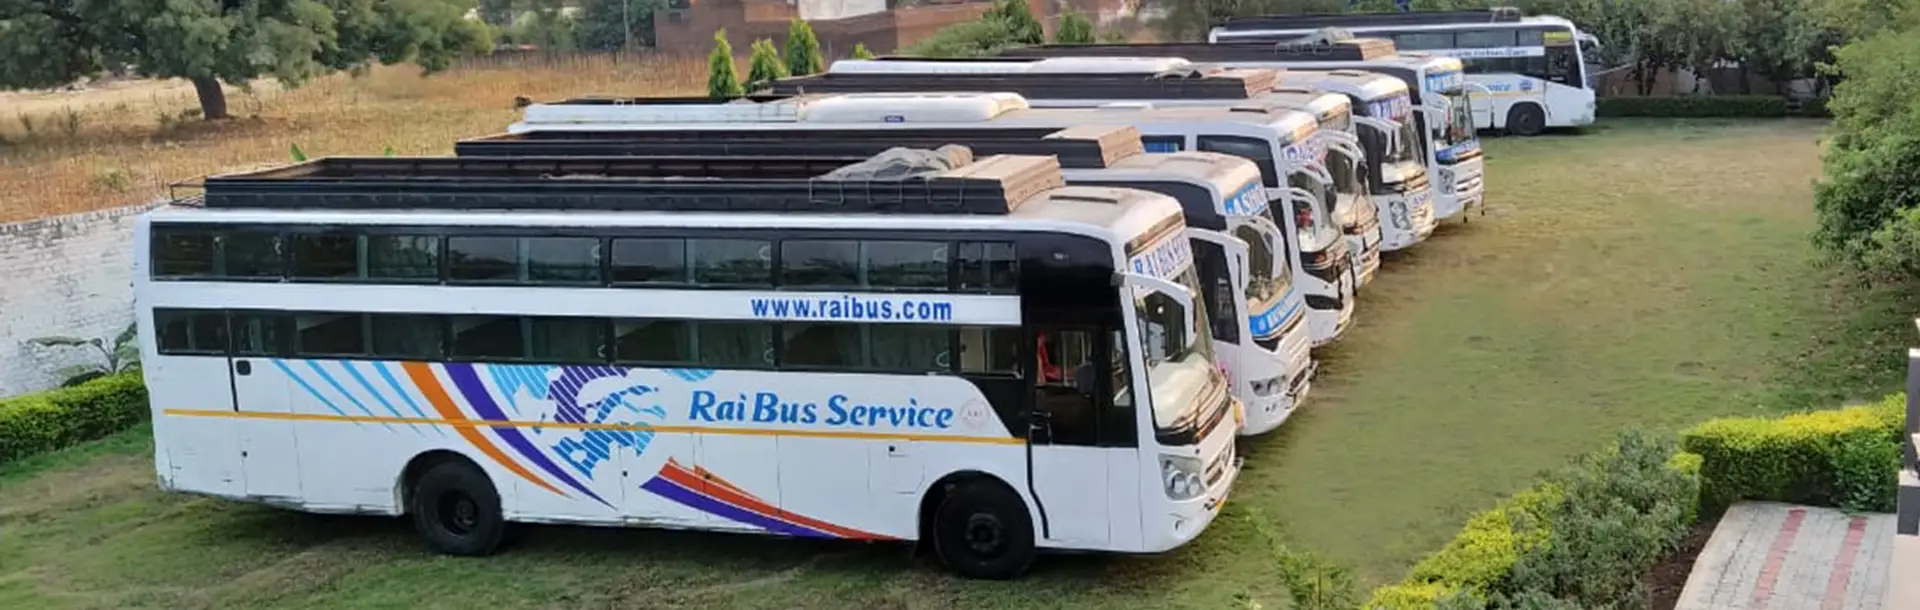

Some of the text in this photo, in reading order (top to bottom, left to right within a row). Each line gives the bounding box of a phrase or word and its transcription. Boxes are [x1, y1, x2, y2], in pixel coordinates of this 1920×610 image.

[751, 296, 952, 320] www.raibus.com
[689, 390, 953, 428] Rai Bus Service
